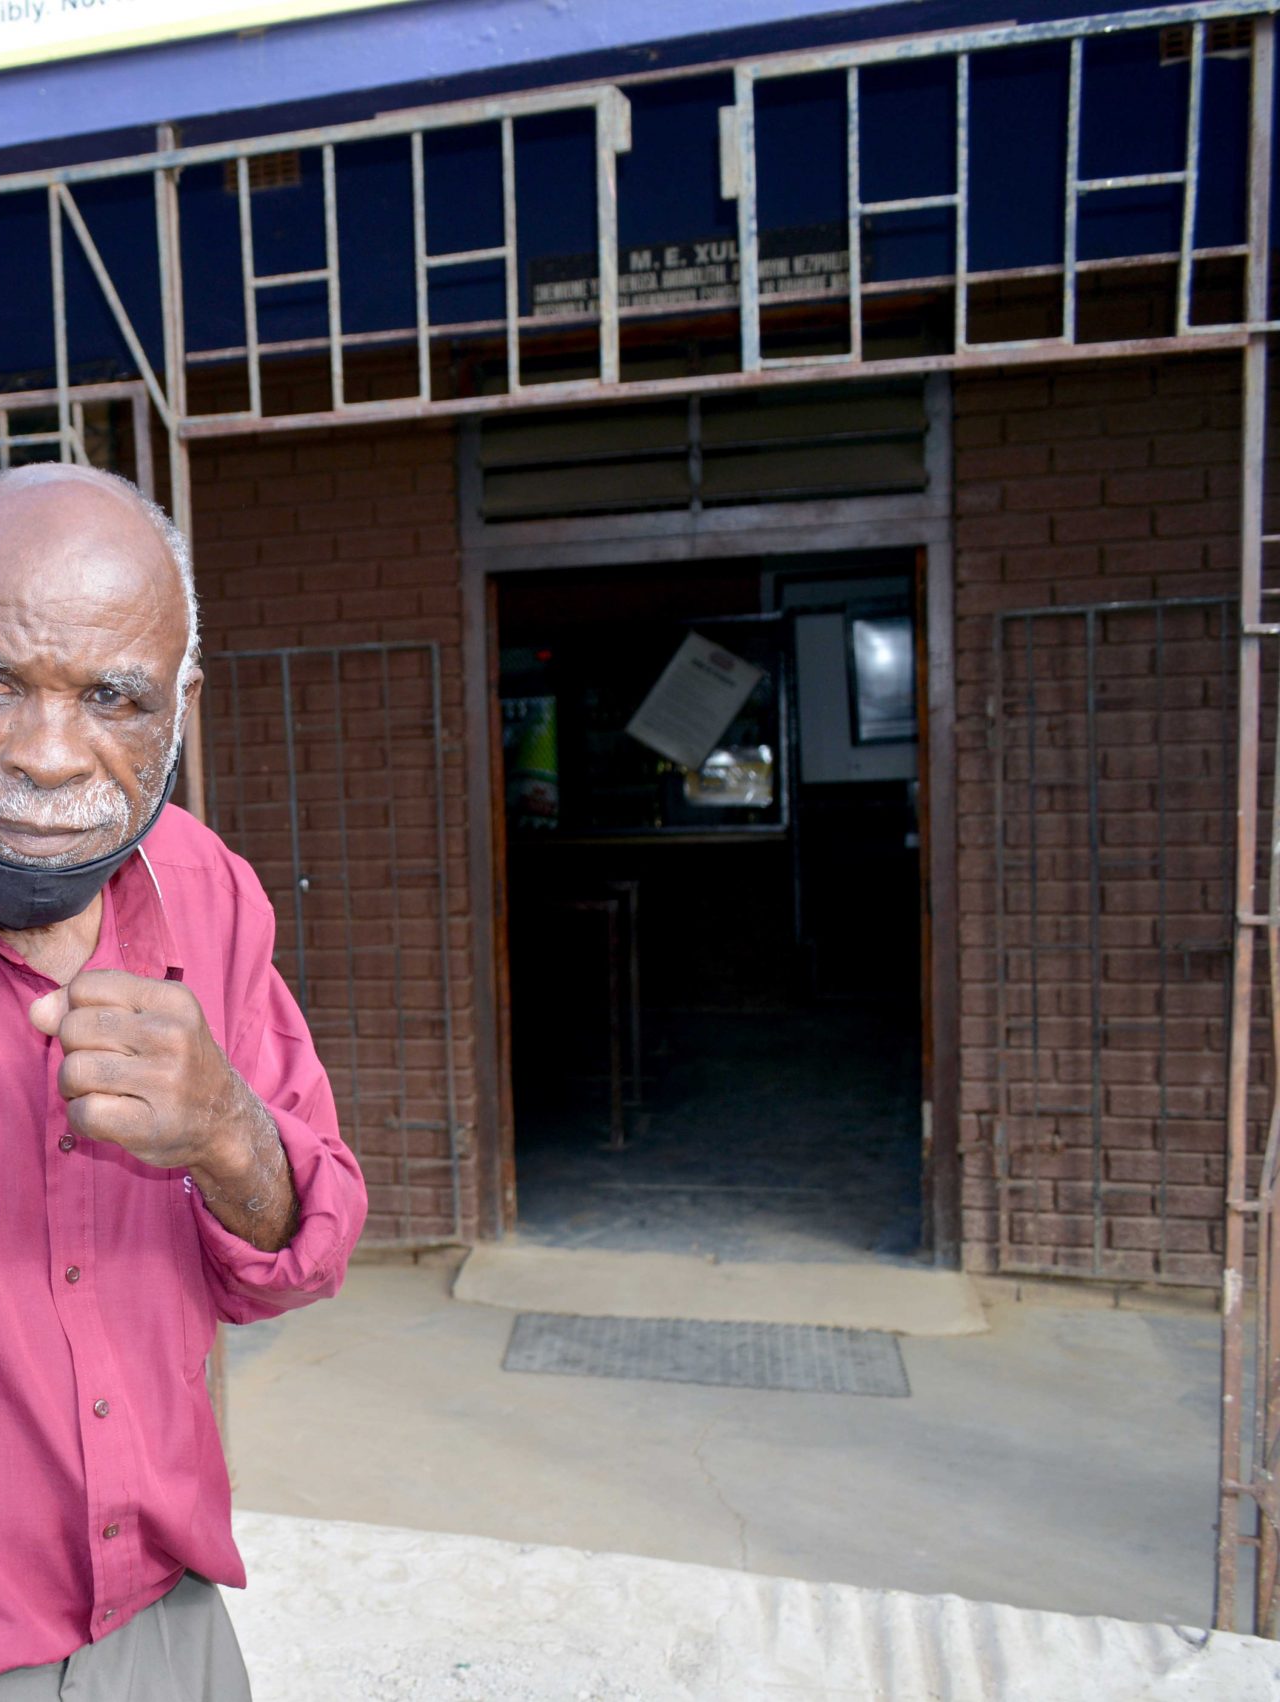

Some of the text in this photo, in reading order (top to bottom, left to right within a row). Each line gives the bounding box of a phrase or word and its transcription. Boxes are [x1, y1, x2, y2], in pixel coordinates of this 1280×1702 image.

[629, 237, 759, 272] M. E. XUL
